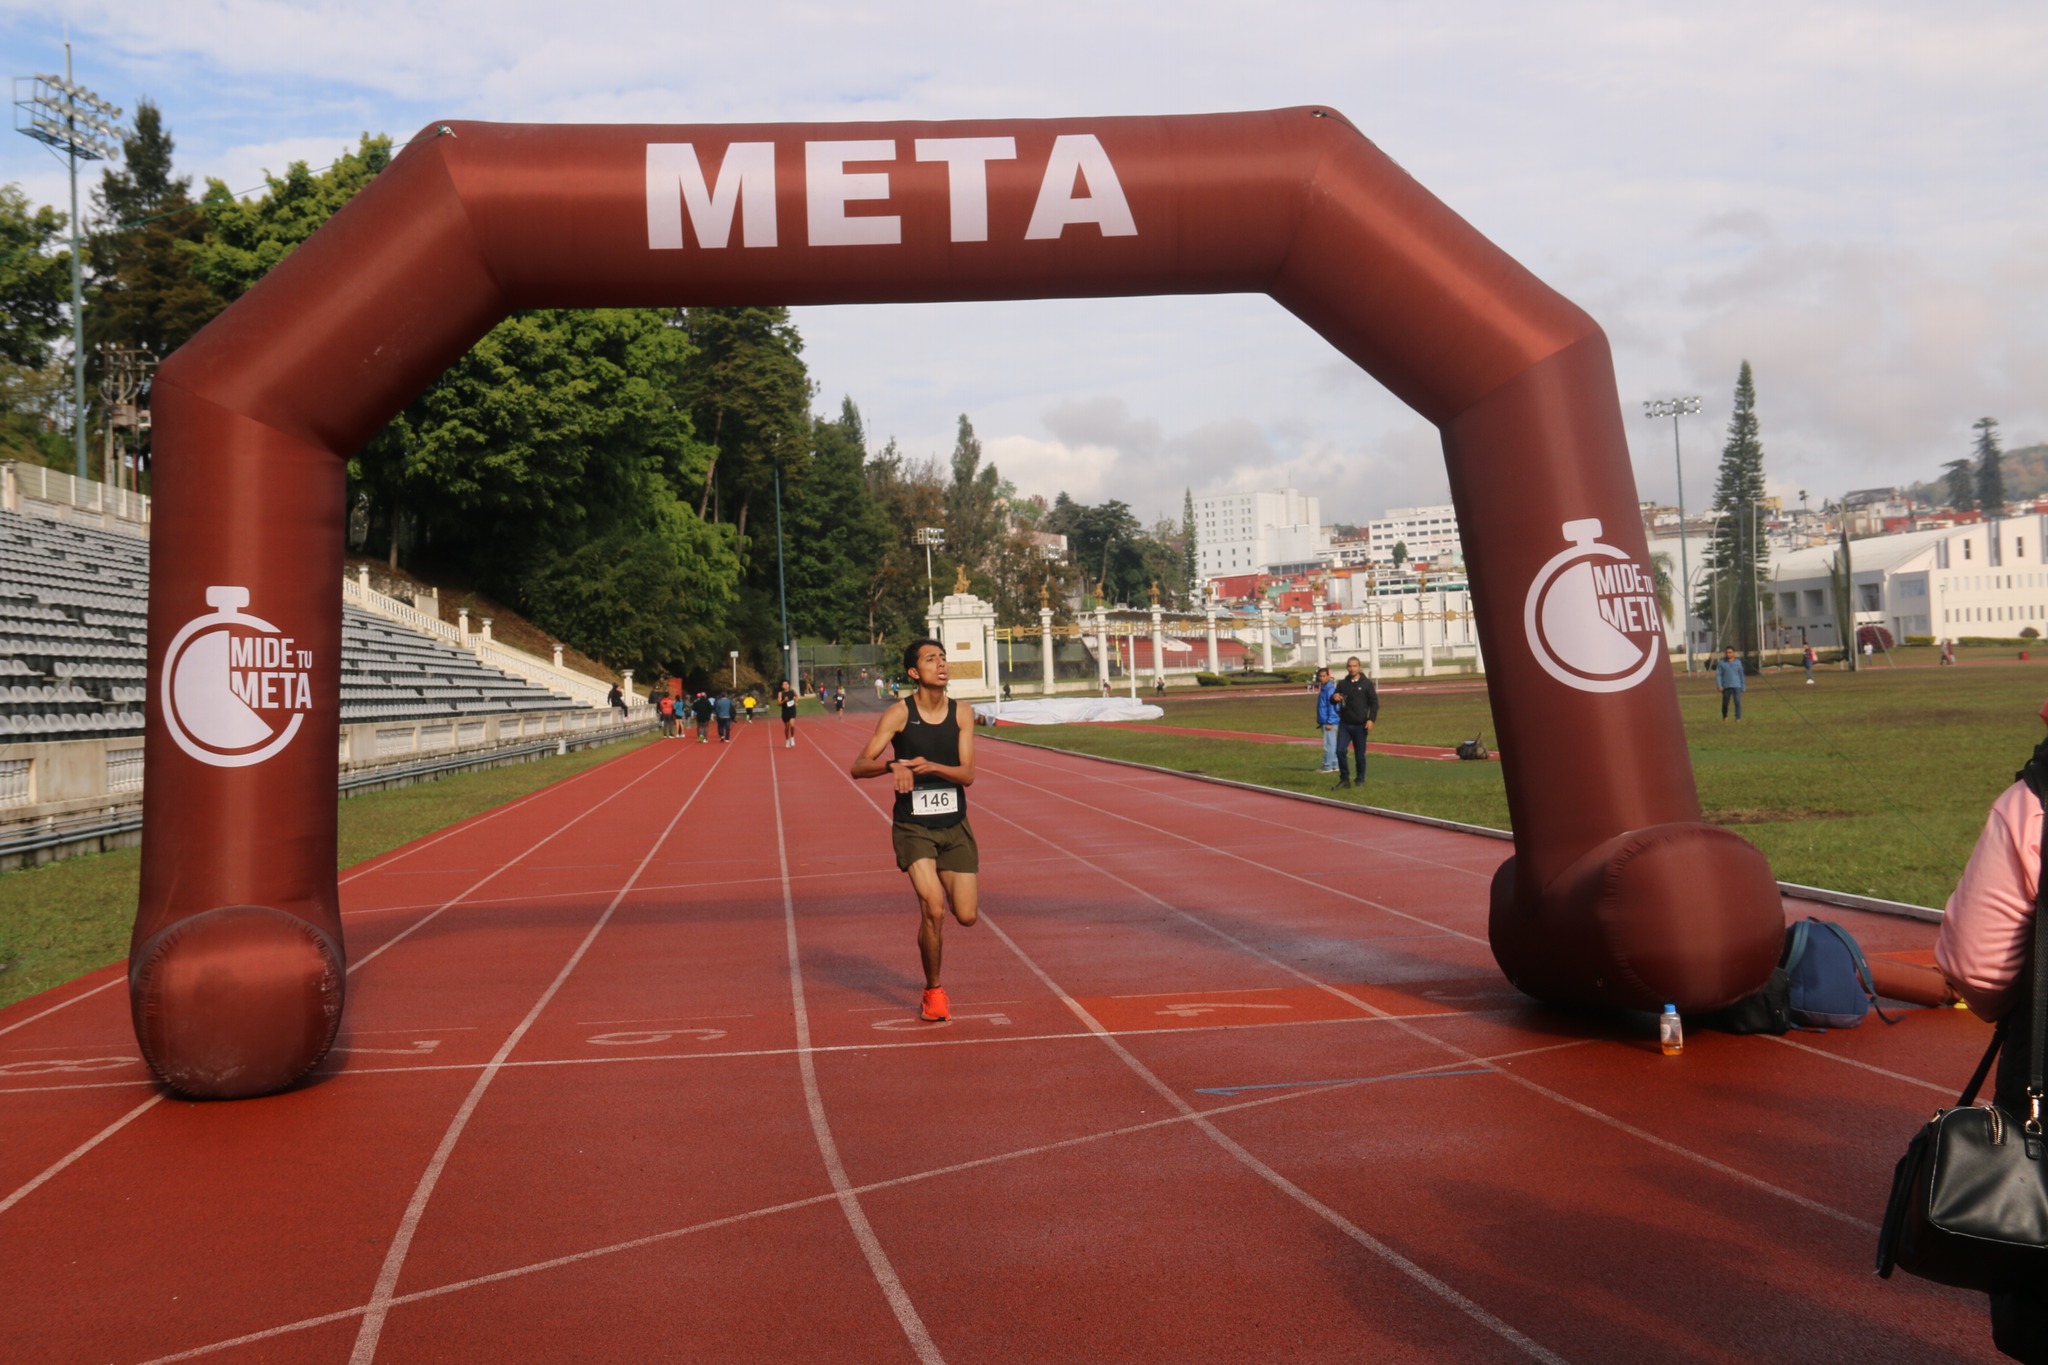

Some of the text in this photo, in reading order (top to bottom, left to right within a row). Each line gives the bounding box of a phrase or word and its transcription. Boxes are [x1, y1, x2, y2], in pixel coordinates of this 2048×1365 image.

[646, 134, 1138, 249] META
[1593, 564, 1653, 595] MIDE TU
[1600, 596, 1661, 632] META
[231, 637, 312, 669] MIDE TU
[231, 671, 312, 708] META
[921, 792, 949, 808] 146
